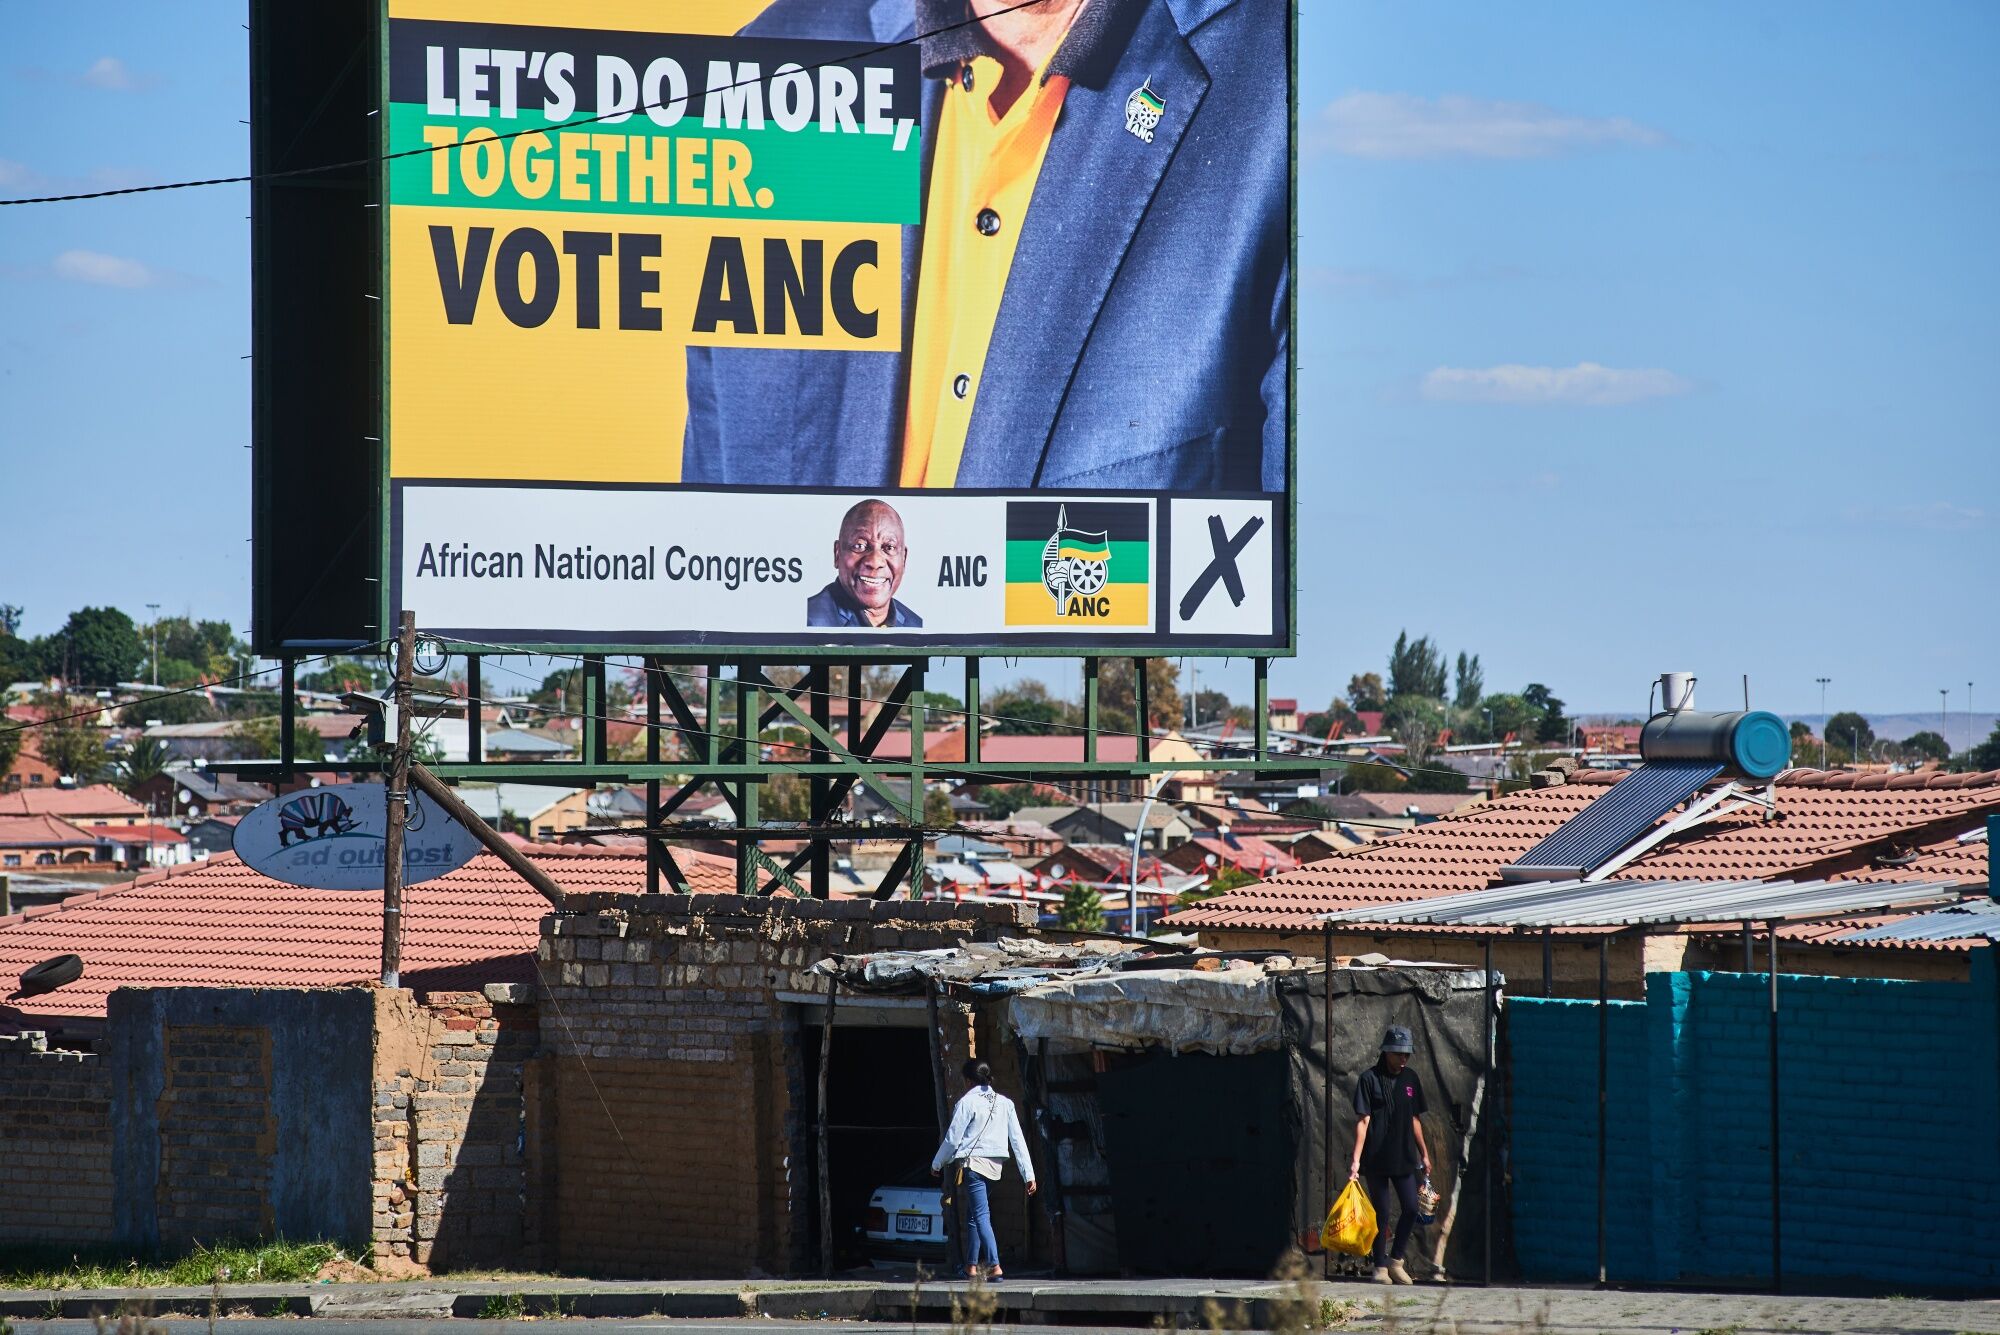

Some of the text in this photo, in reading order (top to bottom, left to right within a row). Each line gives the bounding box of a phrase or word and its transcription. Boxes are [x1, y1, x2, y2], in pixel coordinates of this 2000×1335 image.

[426, 46, 915, 151] LET'S DO MORE,
[1130, 121, 1154, 143] ANC
[424, 126, 775, 208] TOGETHER.
[428, 225, 879, 338] VOTE ANC
[416, 542, 802, 590] African National Congress
[937, 555, 987, 587] ANC
[1067, 597, 1110, 617] ANC
[291, 844, 454, 865] ad outost
